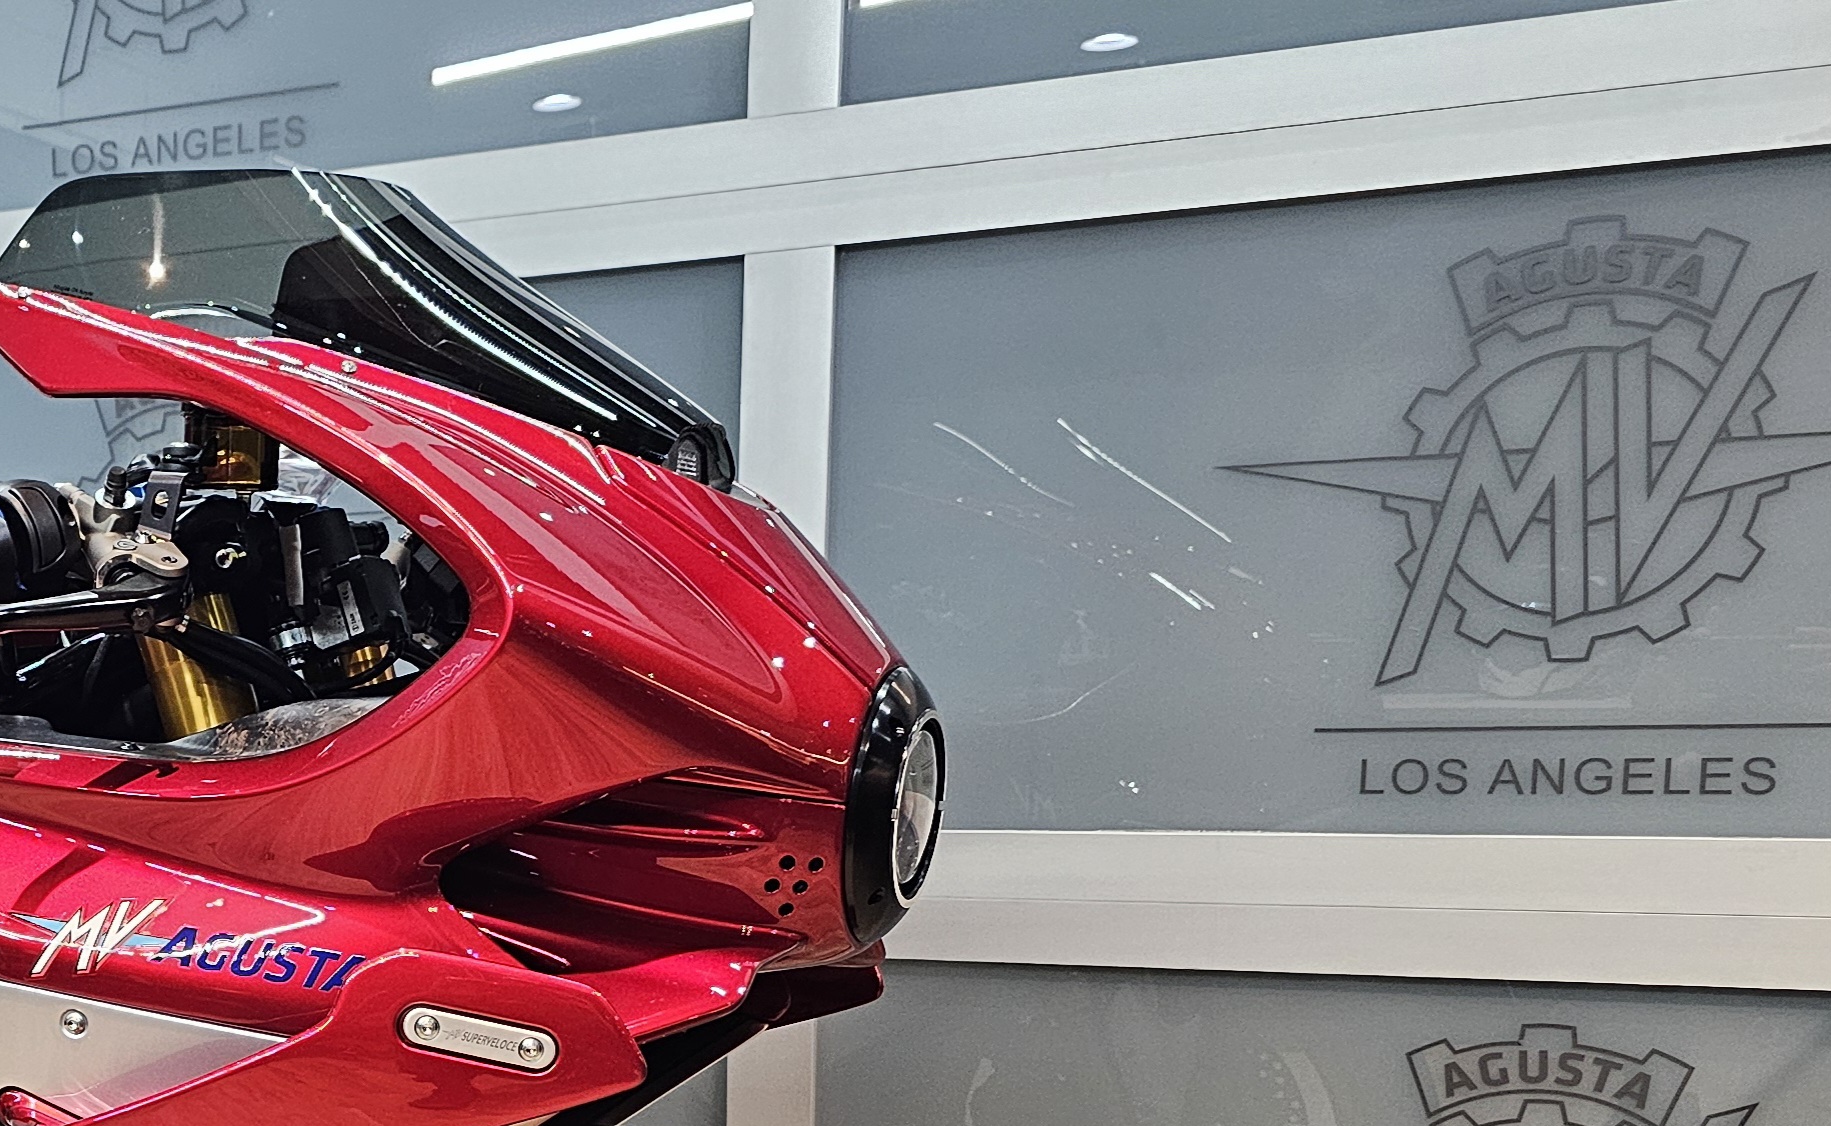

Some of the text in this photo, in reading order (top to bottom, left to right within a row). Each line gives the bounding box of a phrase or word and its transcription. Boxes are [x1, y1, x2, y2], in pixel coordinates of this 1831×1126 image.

[51, 115, 307, 178] LOS ANGELES
[1483, 243, 1706, 313] AGUSTA
[1358, 756, 1777, 796] LOS ANGELES
[31, 898, 168, 978] MV
[461, 1031, 519, 1052] SUPERVELOCE
[1443, 1049, 1653, 1111] AGUSTA
